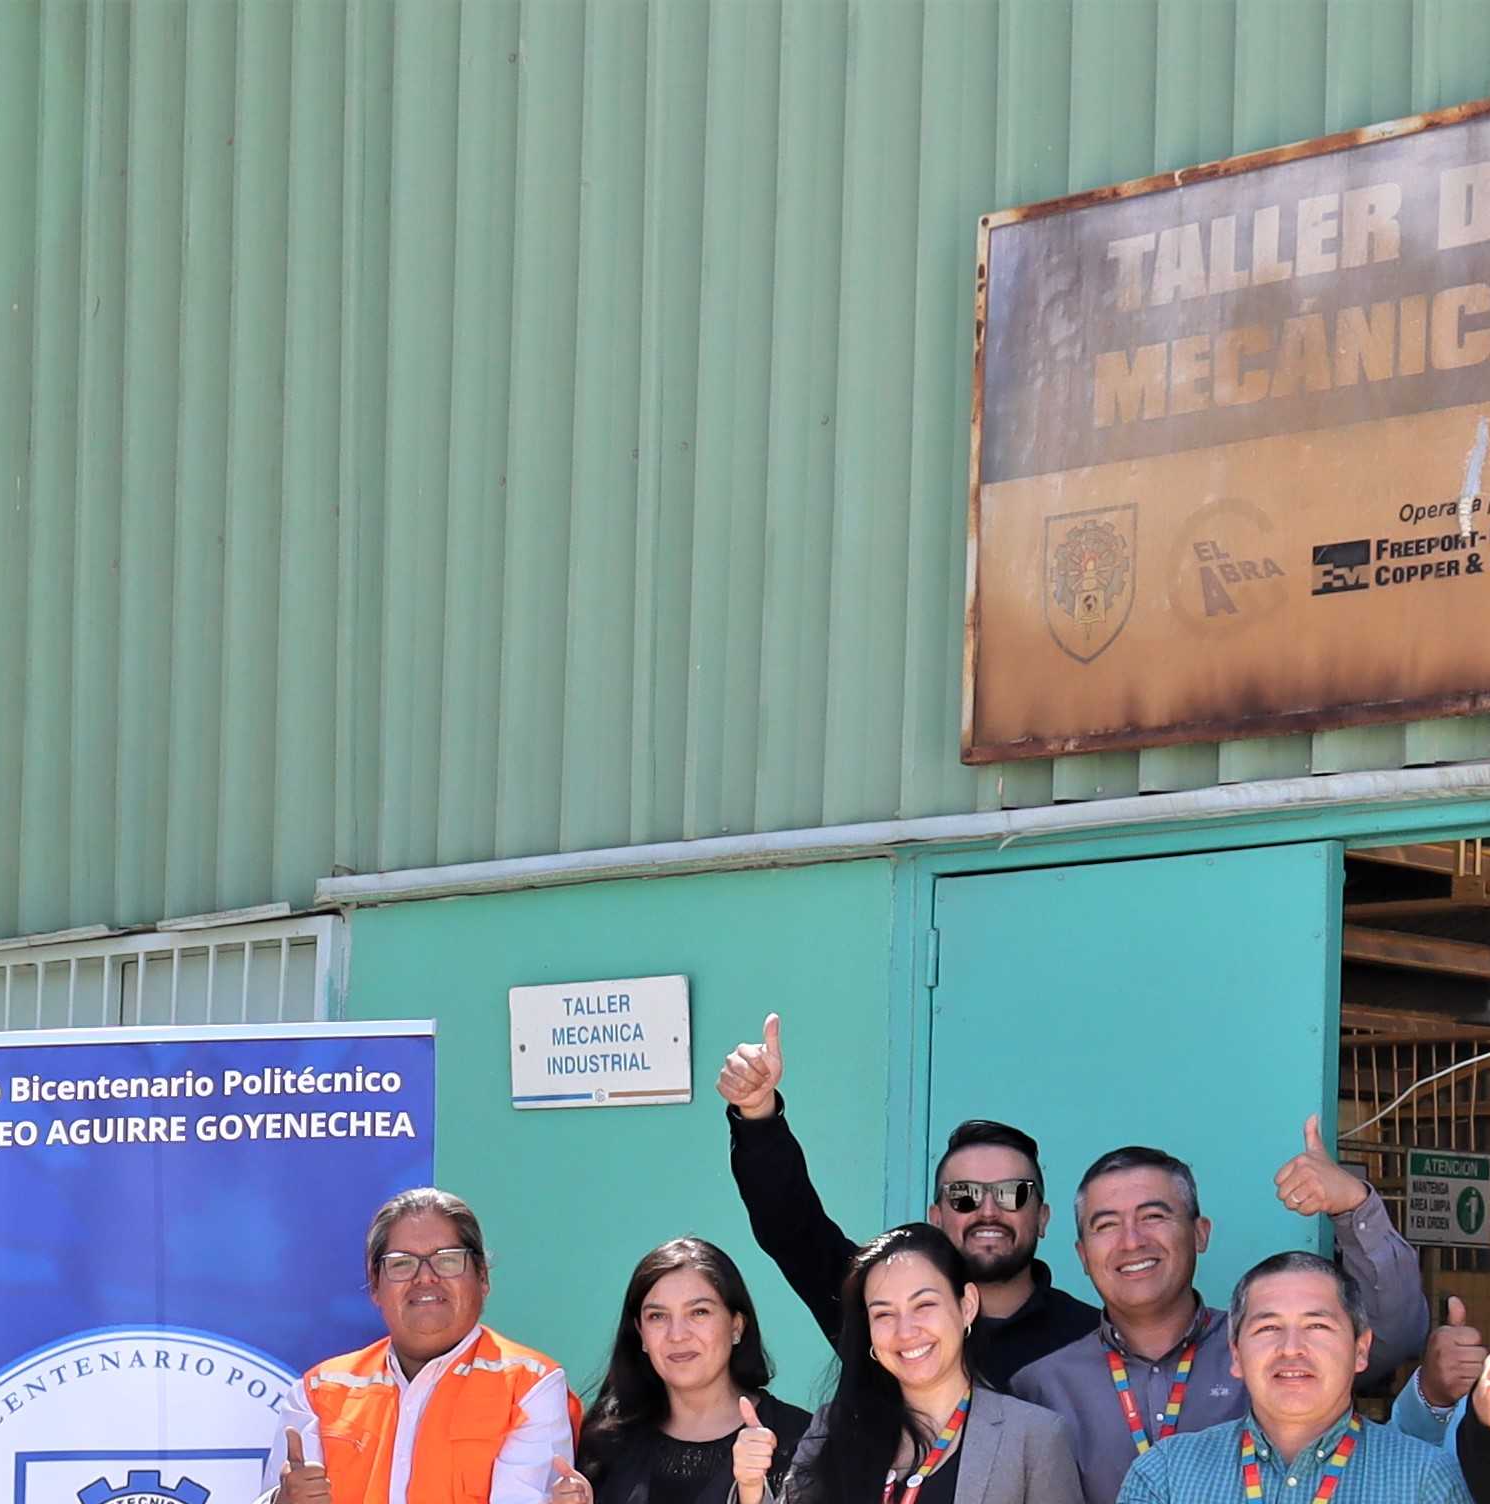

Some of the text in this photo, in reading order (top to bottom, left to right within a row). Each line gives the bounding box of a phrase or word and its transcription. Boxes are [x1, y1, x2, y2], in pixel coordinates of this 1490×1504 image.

[1107, 182, 1403, 313] TALLER
[1399, 498, 1482, 526] Operaa
[1193, 540, 1230, 562] EL
[1465, 552, 1483, 574] &
[563, 994, 631, 1017] TALLER
[552, 1023, 645, 1046] MECANICA
[547, 1053, 651, 1075] INDUSTRIAL
[10, 1070, 214, 1102] Bicentenario
[223, 1065, 402, 1096] Politécnico
[45, 1113, 187, 1145] AGUIRRE
[196, 1110, 416, 1141] GOYENECHEA
